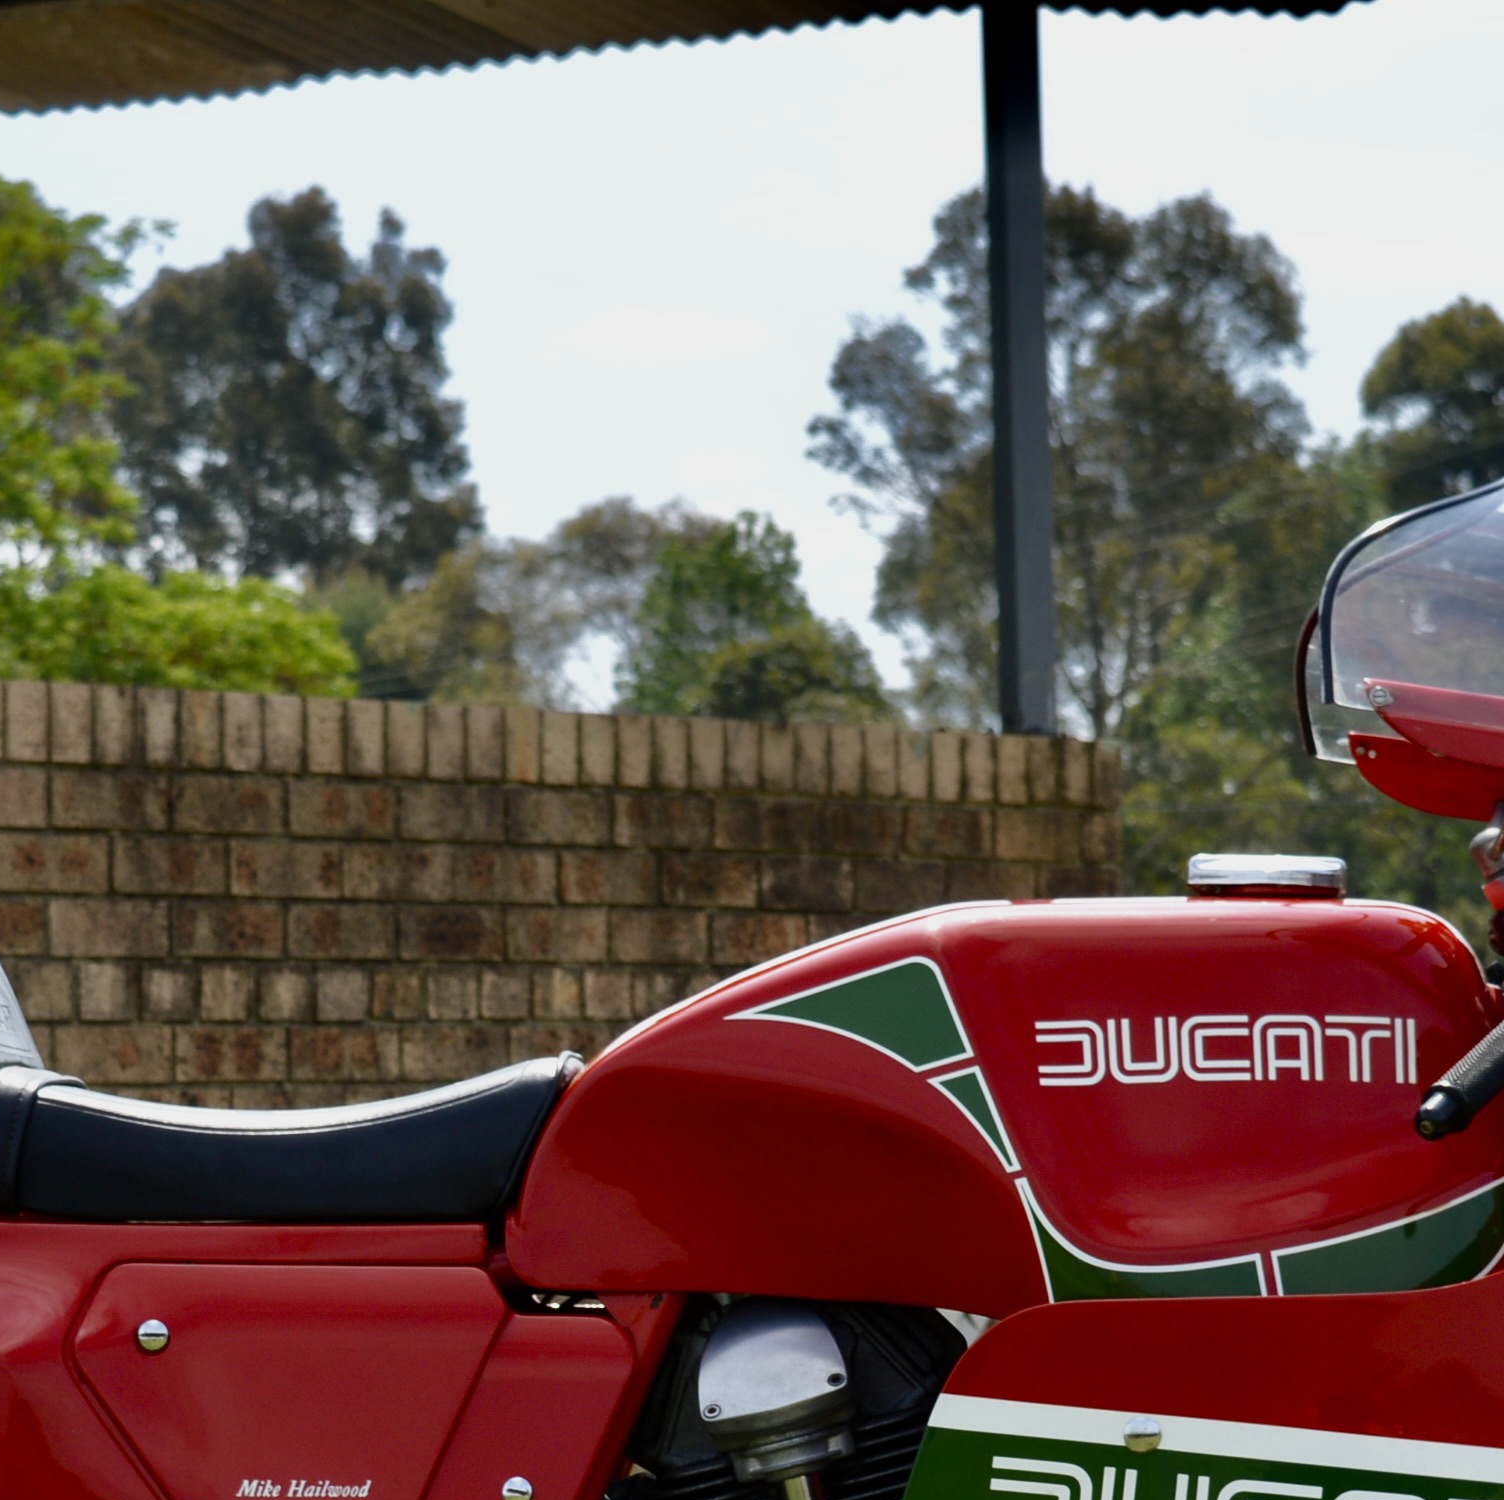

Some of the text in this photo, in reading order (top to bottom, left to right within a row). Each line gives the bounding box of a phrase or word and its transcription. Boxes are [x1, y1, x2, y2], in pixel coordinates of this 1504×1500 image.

[1035, 1014, 1418, 1087] DUCATI
[236, 1479, 372, 1498] Mike Hailwood
